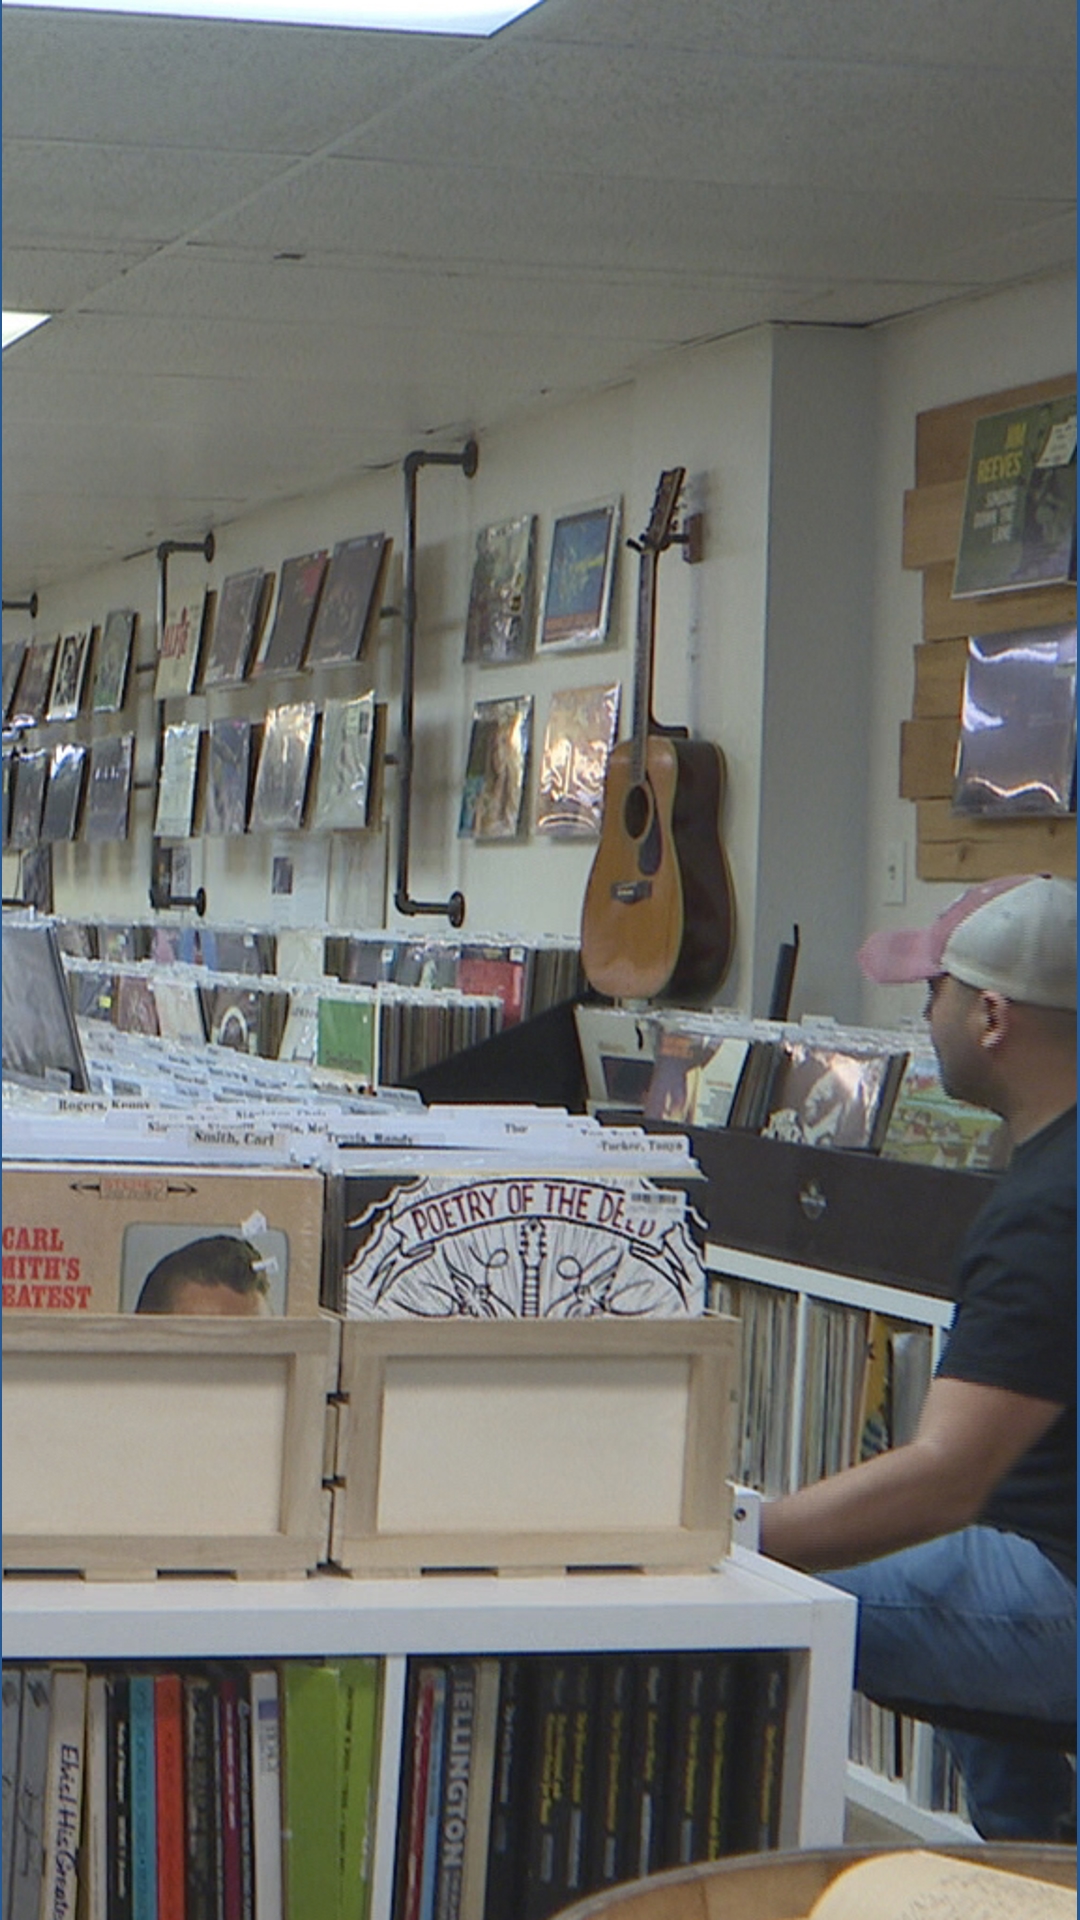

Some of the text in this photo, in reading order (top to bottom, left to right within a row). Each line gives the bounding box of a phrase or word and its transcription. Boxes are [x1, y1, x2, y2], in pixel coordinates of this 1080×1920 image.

[195, 1130, 275, 1146] Smith, Carl
[602, 1140, 645, 1152] Tucker,
[411, 1187, 497, 1241] POETRY
[507, 1184, 534, 1214] OF
[544, 1183, 592, 1219] THE
[2, 1226, 65, 1252] CARL
[2, 1256, 80, 1282] MITH'S
[2, 1284, 93, 1310] EATEST
